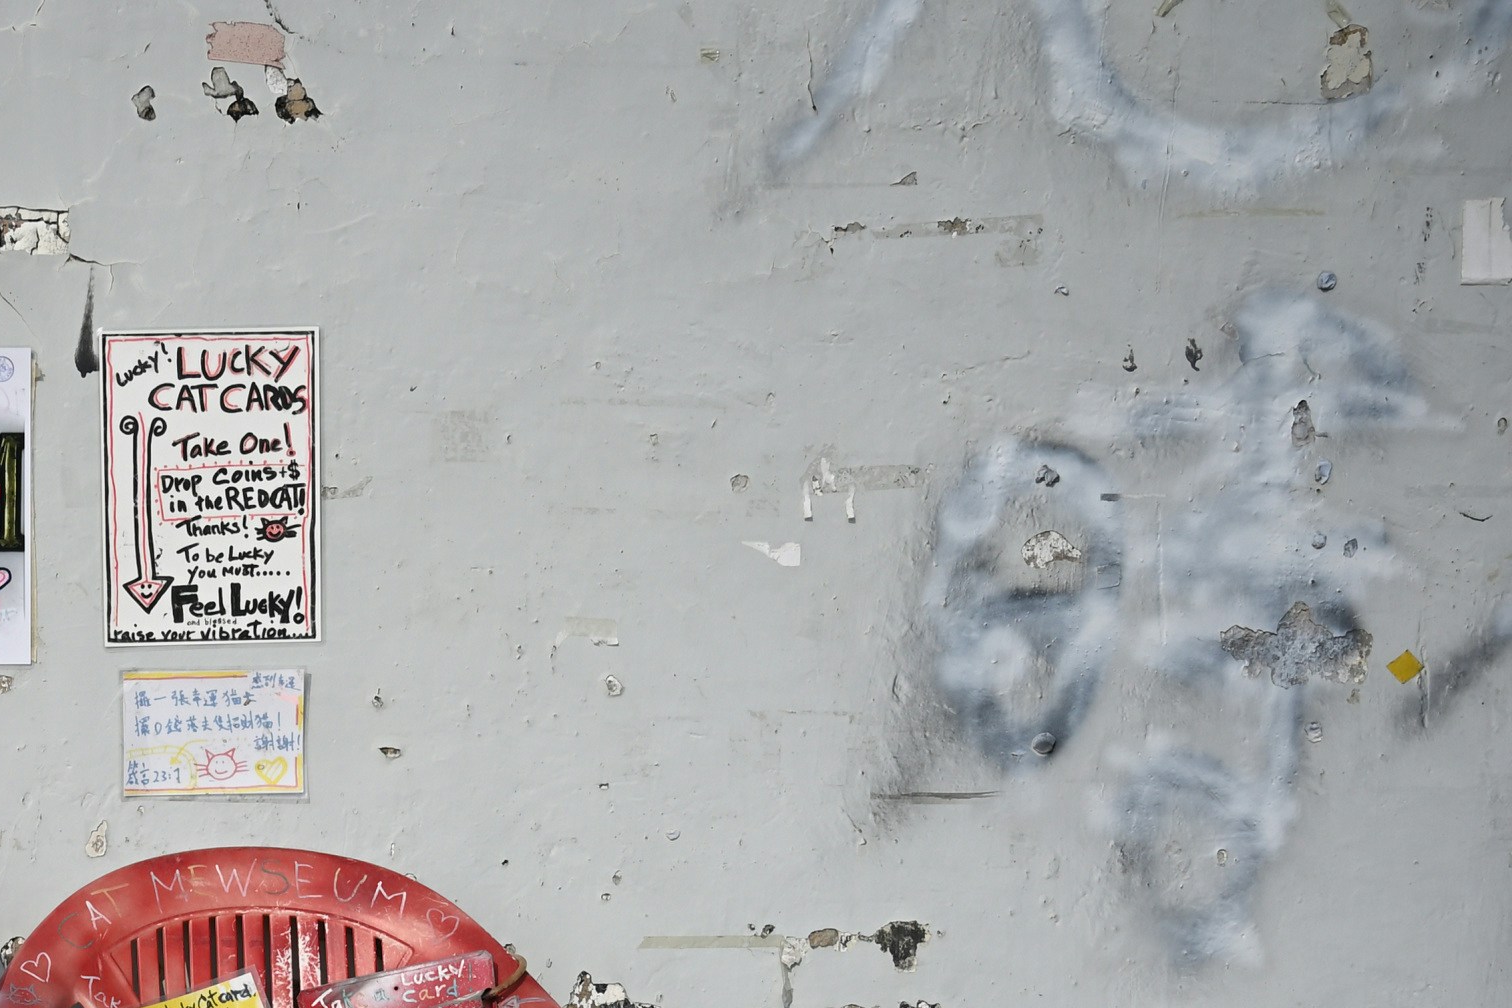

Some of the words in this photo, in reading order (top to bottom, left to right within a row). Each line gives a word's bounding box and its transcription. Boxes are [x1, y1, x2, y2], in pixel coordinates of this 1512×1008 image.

[177, 344, 301, 383] LUCKY
[172, 432, 231, 461] Take
[240, 422, 296, 456] One!
[161, 474, 202, 497] Drop
[169, 495, 187, 513] in
[195, 495, 223, 512] the
[175, 515, 250, 538] Thanks!
[176, 543, 199, 563] To
[205, 547, 224, 563] be
[228, 545, 274, 564] Lucky
[187, 566, 217, 584] you
[171, 585, 226, 623] Feel
[113, 624, 156, 641] raise
[161, 628, 197, 641] your
[57, 883, 129, 949] CAT
